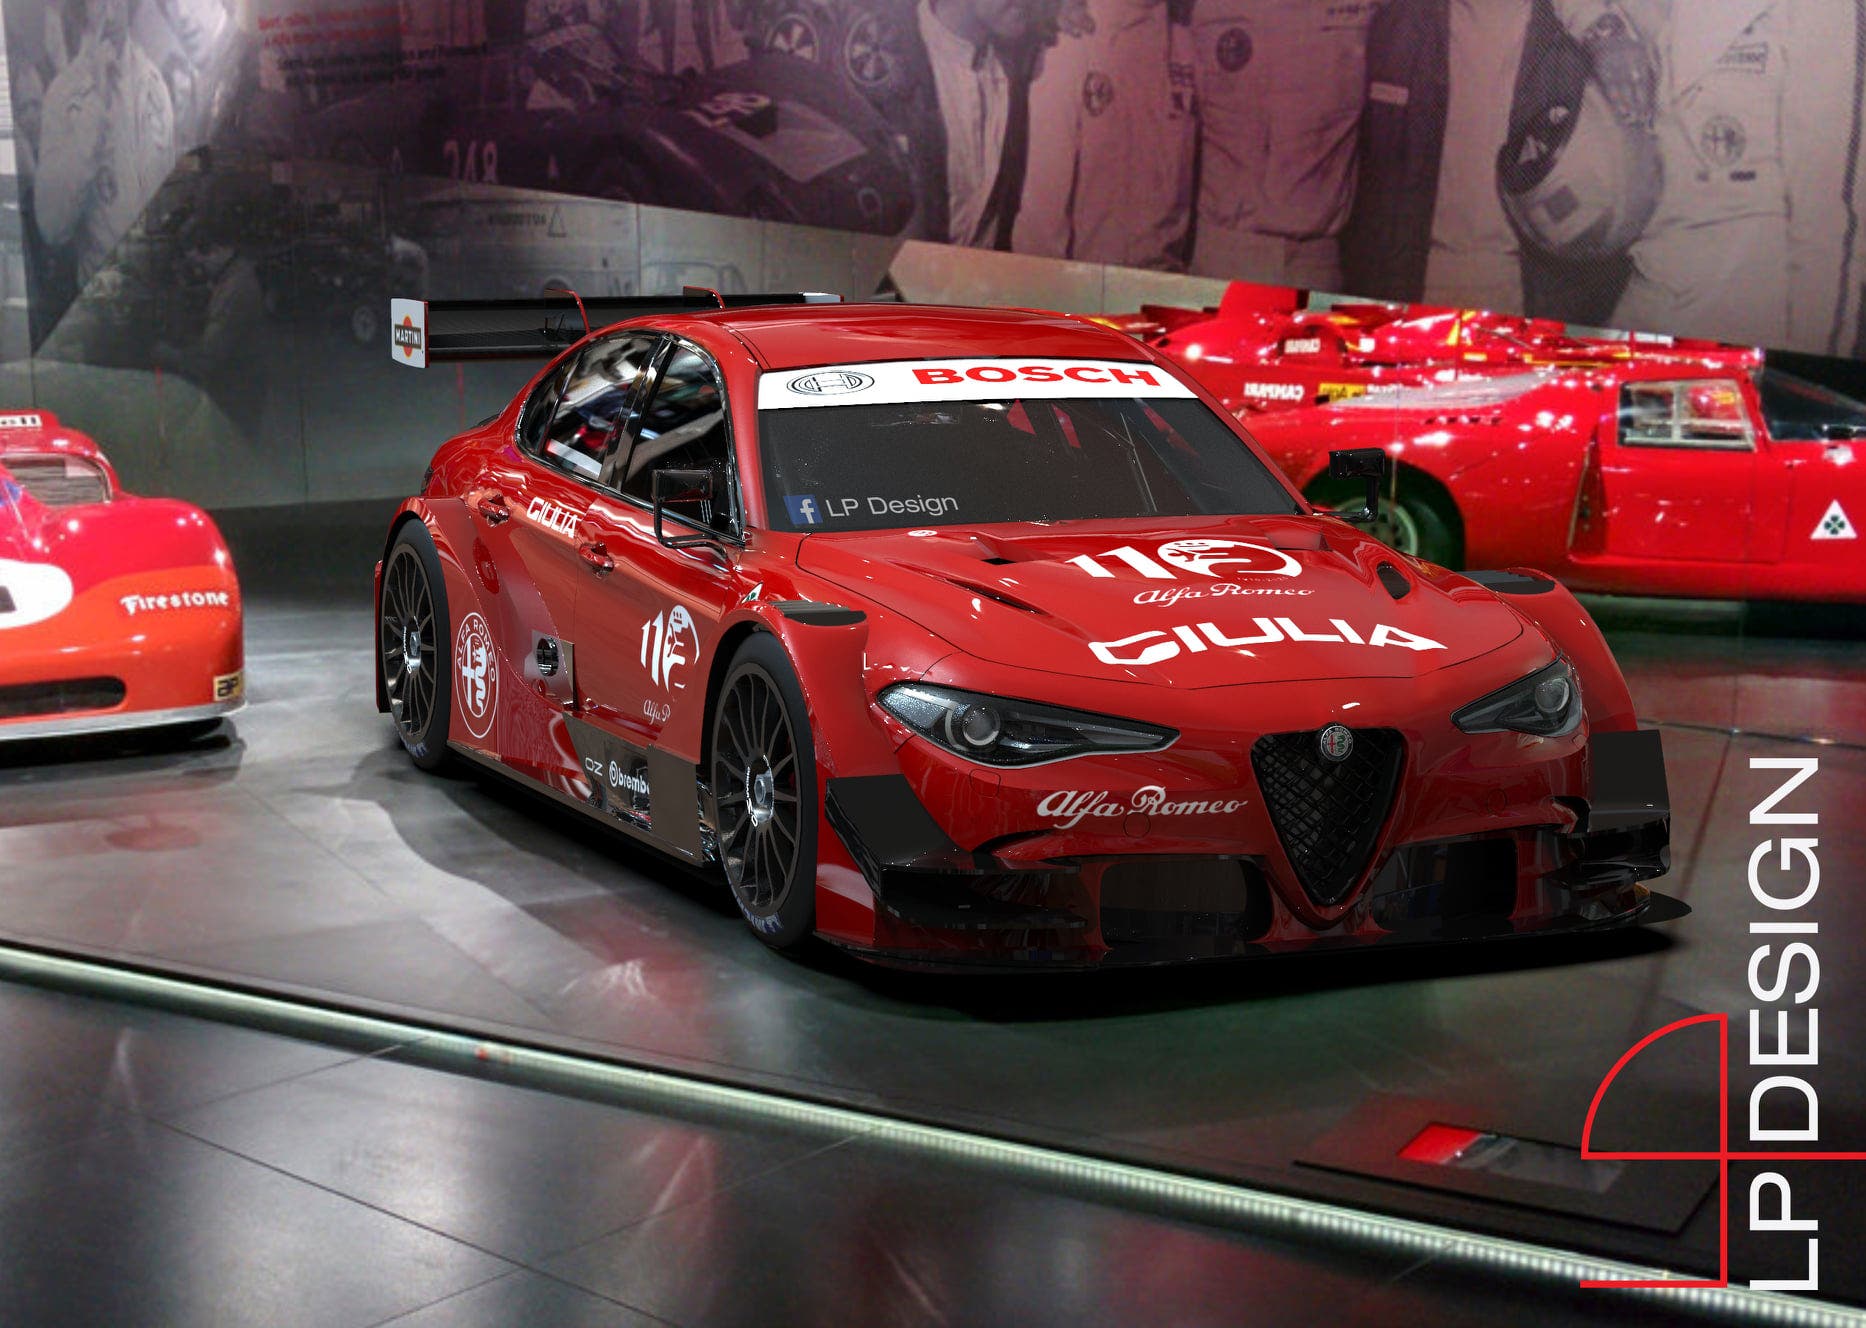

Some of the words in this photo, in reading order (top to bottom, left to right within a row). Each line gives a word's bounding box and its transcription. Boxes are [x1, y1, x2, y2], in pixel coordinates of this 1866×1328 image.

[394, 328, 421, 350] MARTINI
[912, 366, 1161, 386] BOSCH
[527, 496, 580, 539] GIULIA
[824, 498, 859, 518] LP
[868, 494, 959, 518] Design
[120, 591, 229, 617] Firestone
[1133, 586, 1209, 607] Alfa
[1210, 583, 1315, 597] Romeo
[456, 623, 471, 670] ALFA
[473, 619, 496, 682] ROMEO
[1087, 617, 1448, 665] GIULIA
[585, 757, 604, 776] OZ
[1036, 789, 1124, 830] Alfa
[1126, 785, 1249, 816] Romeo
